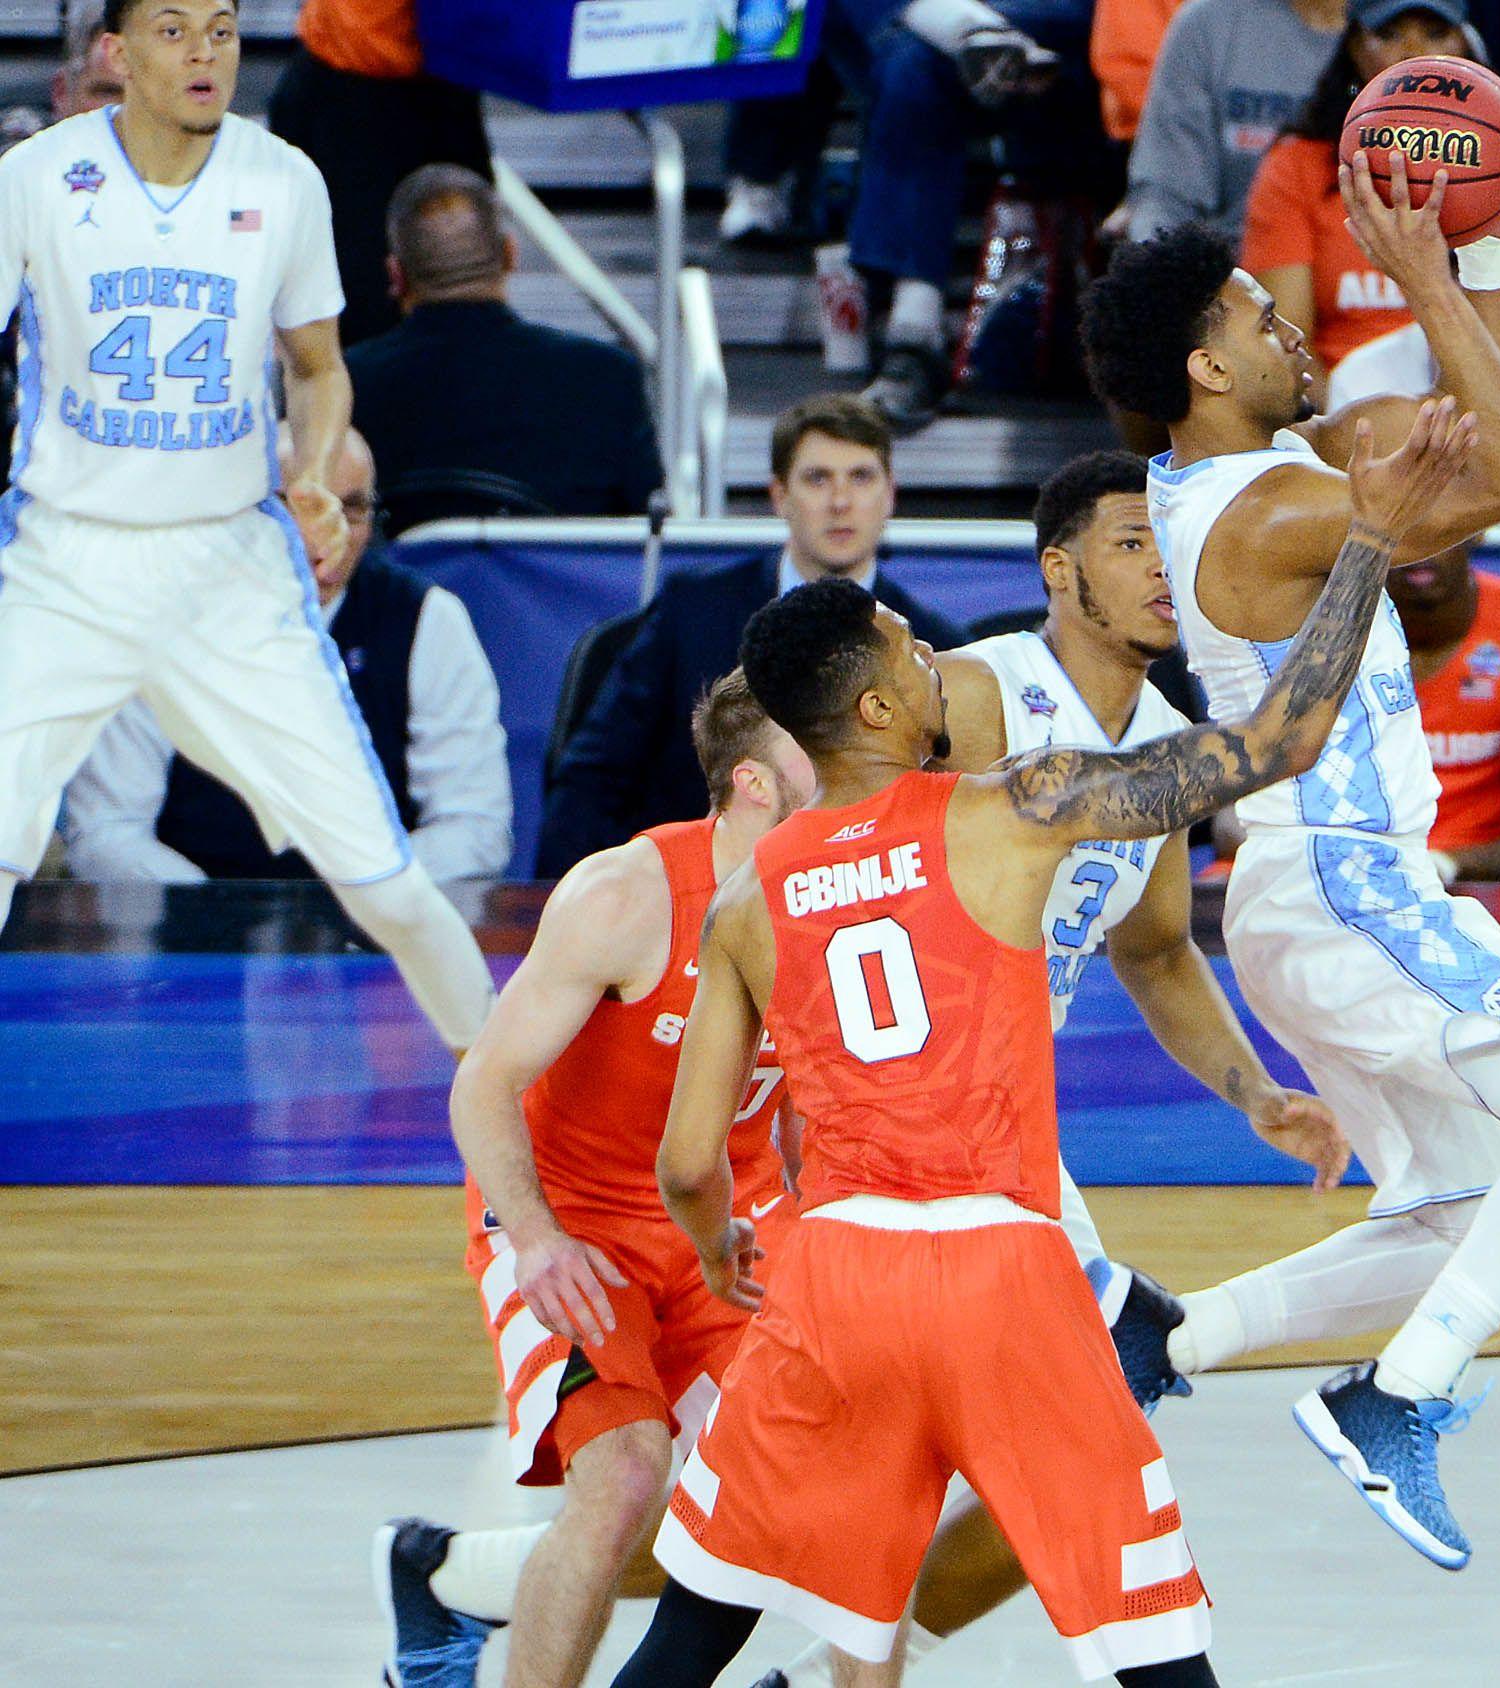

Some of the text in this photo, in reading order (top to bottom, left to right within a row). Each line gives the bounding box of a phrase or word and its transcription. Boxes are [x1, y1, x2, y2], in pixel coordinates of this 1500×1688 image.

[1359, 126, 1481, 167] Wilson
[89, 266, 237, 318] NORTH
[89, 315, 231, 404] 44
[60, 385, 255, 451] CAROLINA
[824, 819, 877, 842] ACC
[783, 841, 928, 918] GBINIJE
[1052, 860, 1119, 949] 3
[824, 915, 932, 1065] 0
